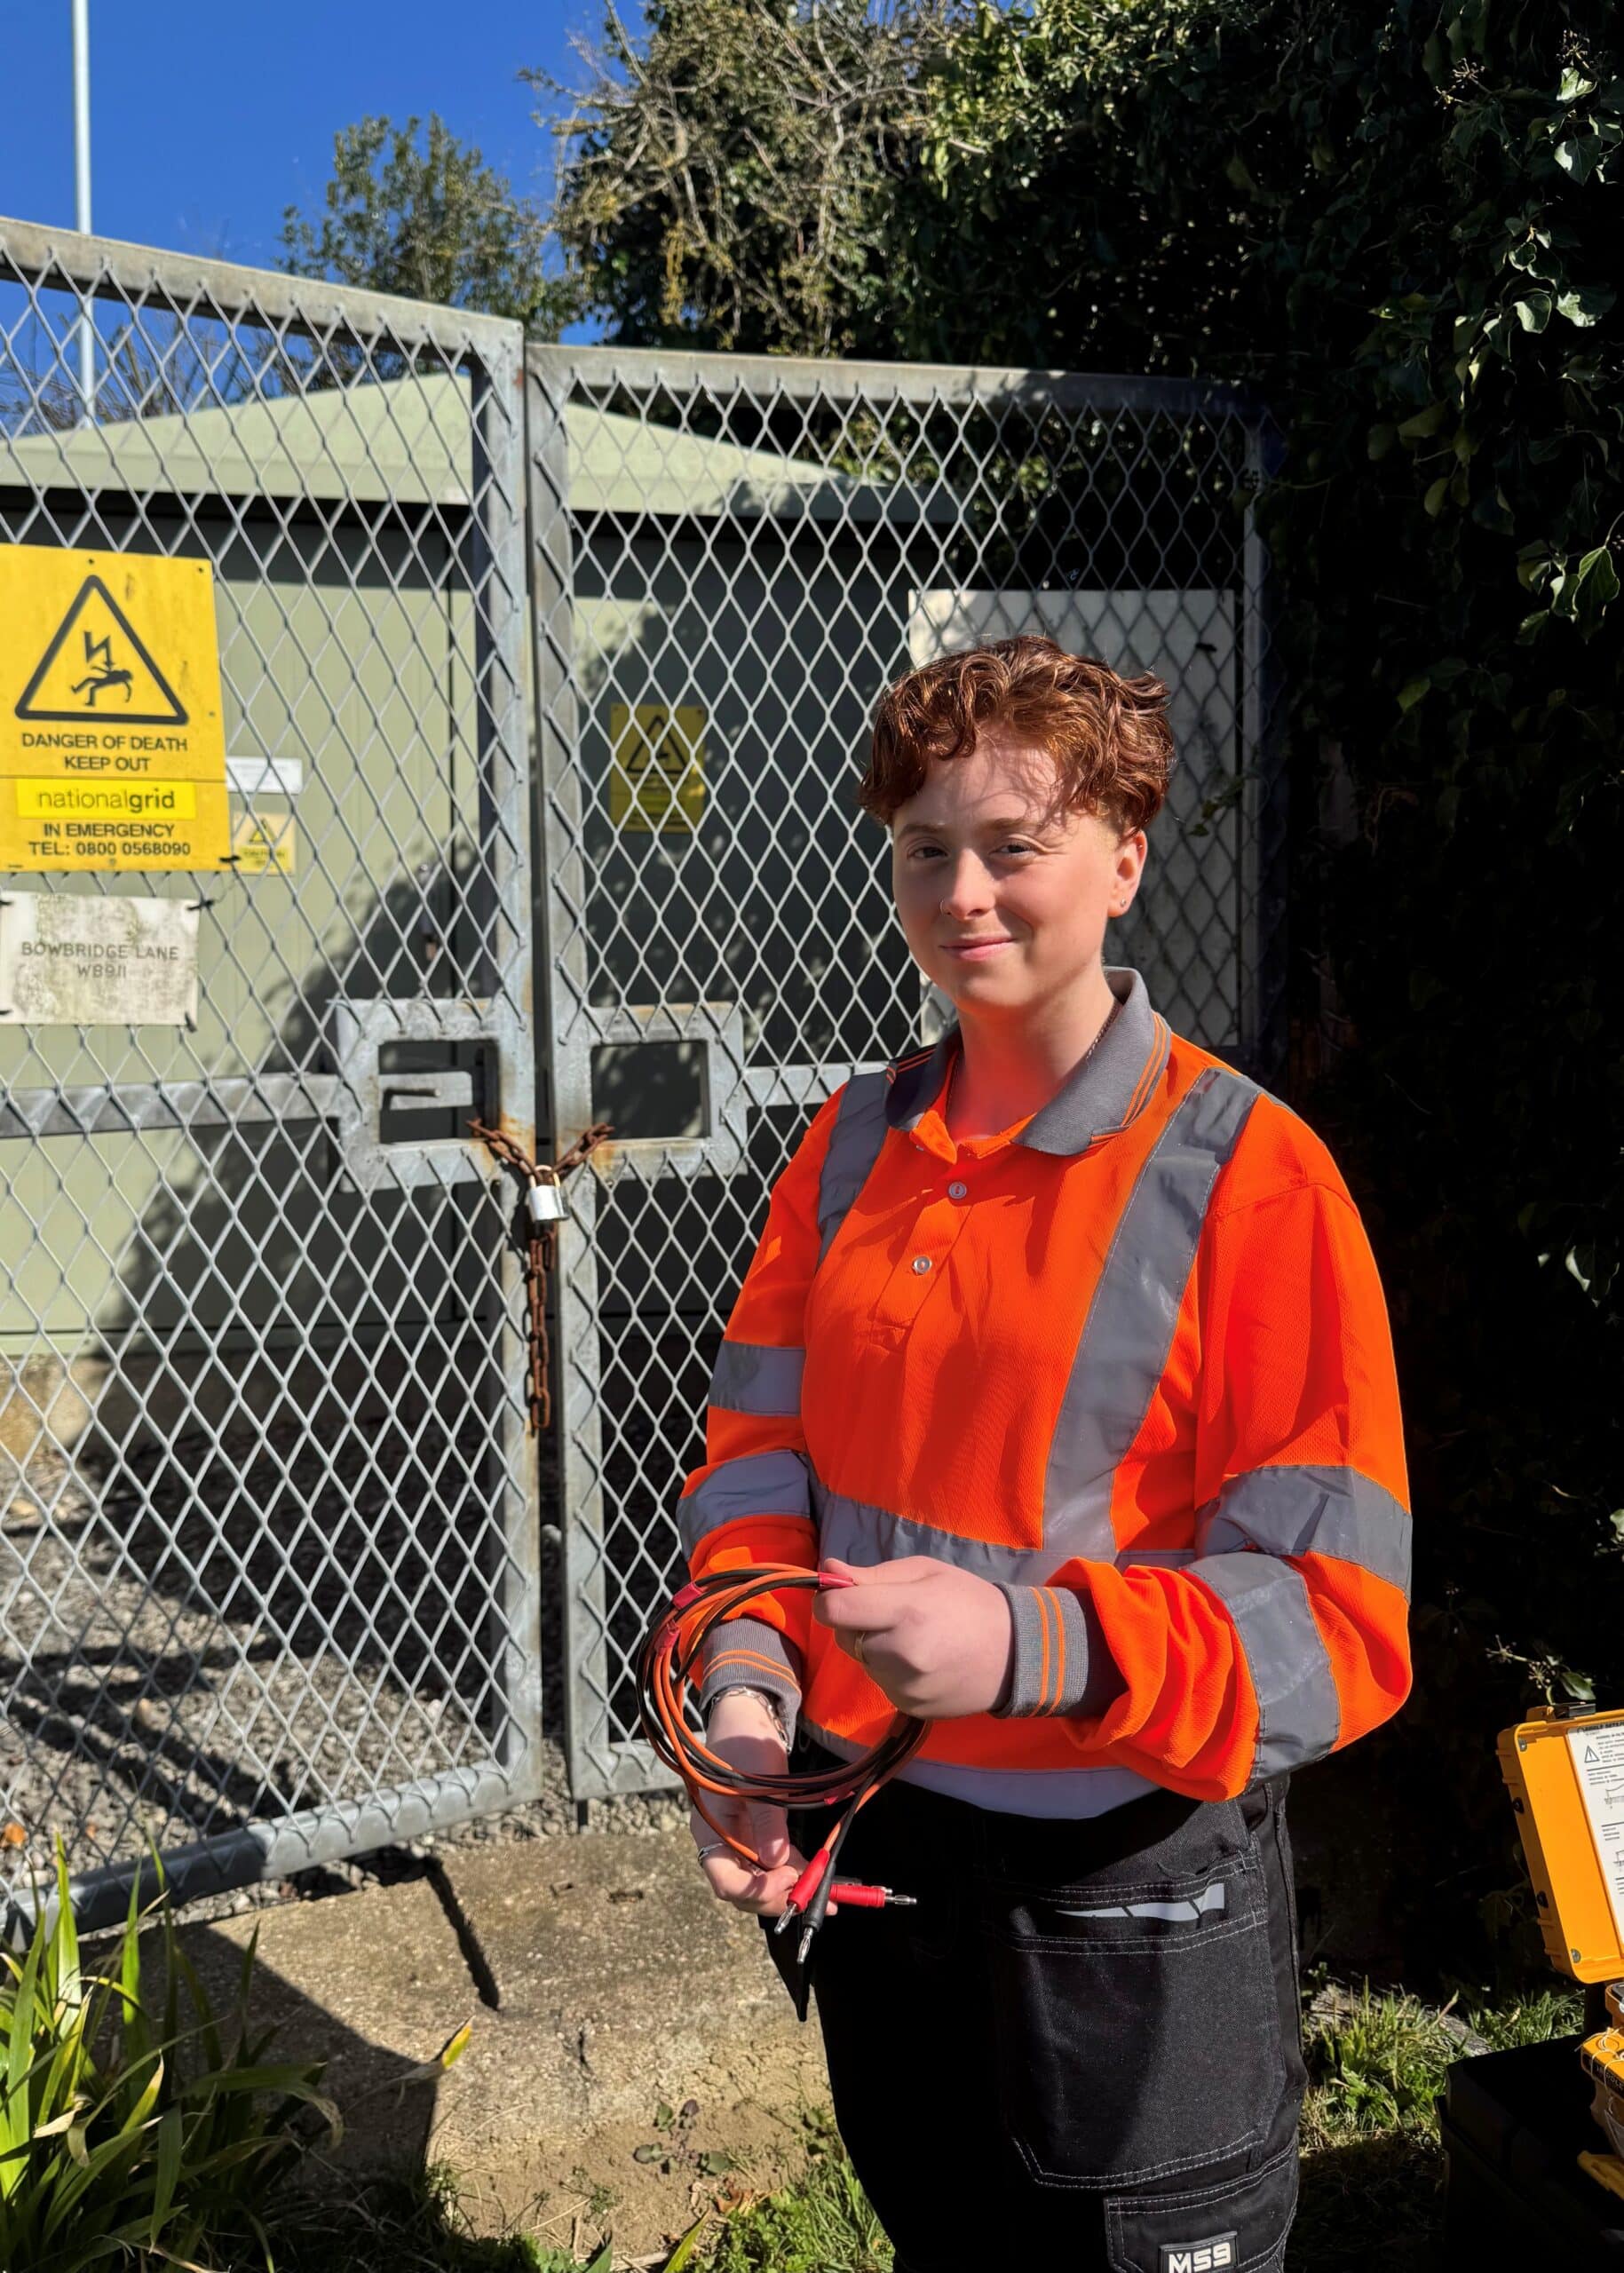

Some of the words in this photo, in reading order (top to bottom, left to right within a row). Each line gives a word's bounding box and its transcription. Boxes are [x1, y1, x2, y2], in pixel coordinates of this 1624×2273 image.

[22, 733, 98, 749] DANGER
[102, 735, 125, 749] OF
[131, 736, 188, 751] DEATH
[65, 756, 110, 771] KEEP
[115, 756, 151, 772] OUT
[38, 788, 176, 813] nationalgrid
[44, 823, 60, 837] IN
[66, 823, 175, 838] EMERGENCY
[28, 841, 70, 856] TEL:
[75, 842, 117, 856] 0800
[122, 842, 192, 856] 0568090
[21, 941, 129, 960] BOWBRIDGE
[135, 946, 181, 961] LANE
